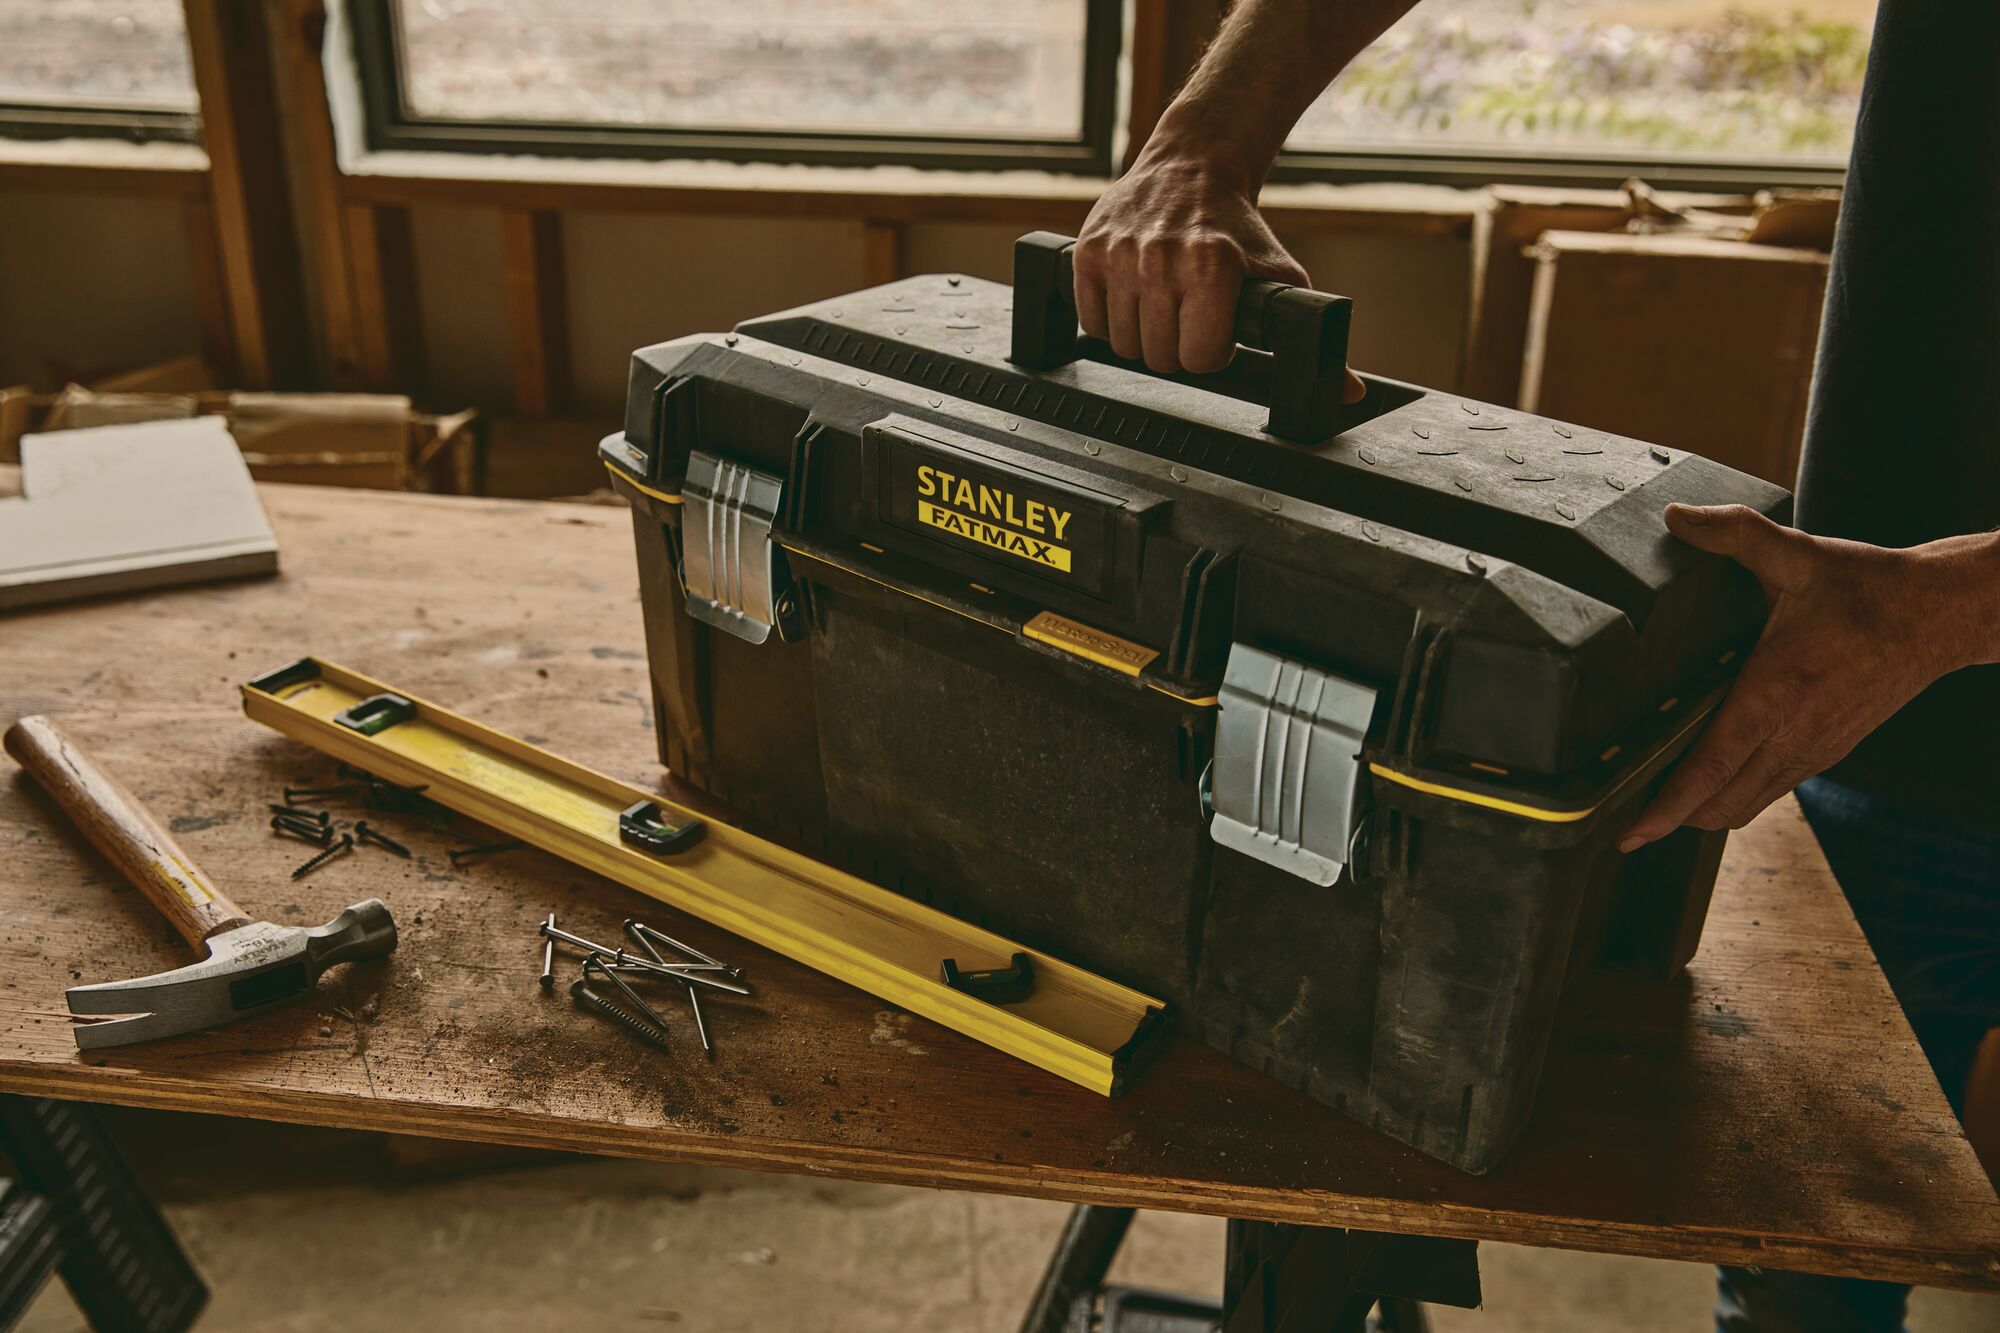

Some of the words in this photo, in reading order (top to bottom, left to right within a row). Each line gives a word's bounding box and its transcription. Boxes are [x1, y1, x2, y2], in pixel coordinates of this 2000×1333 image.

[917, 465, 1072, 541] STANLEY
[932, 508, 1053, 564] FATMAX
[1039, 616, 1098, 645] Water
[1100, 640, 1149, 664] Seal
